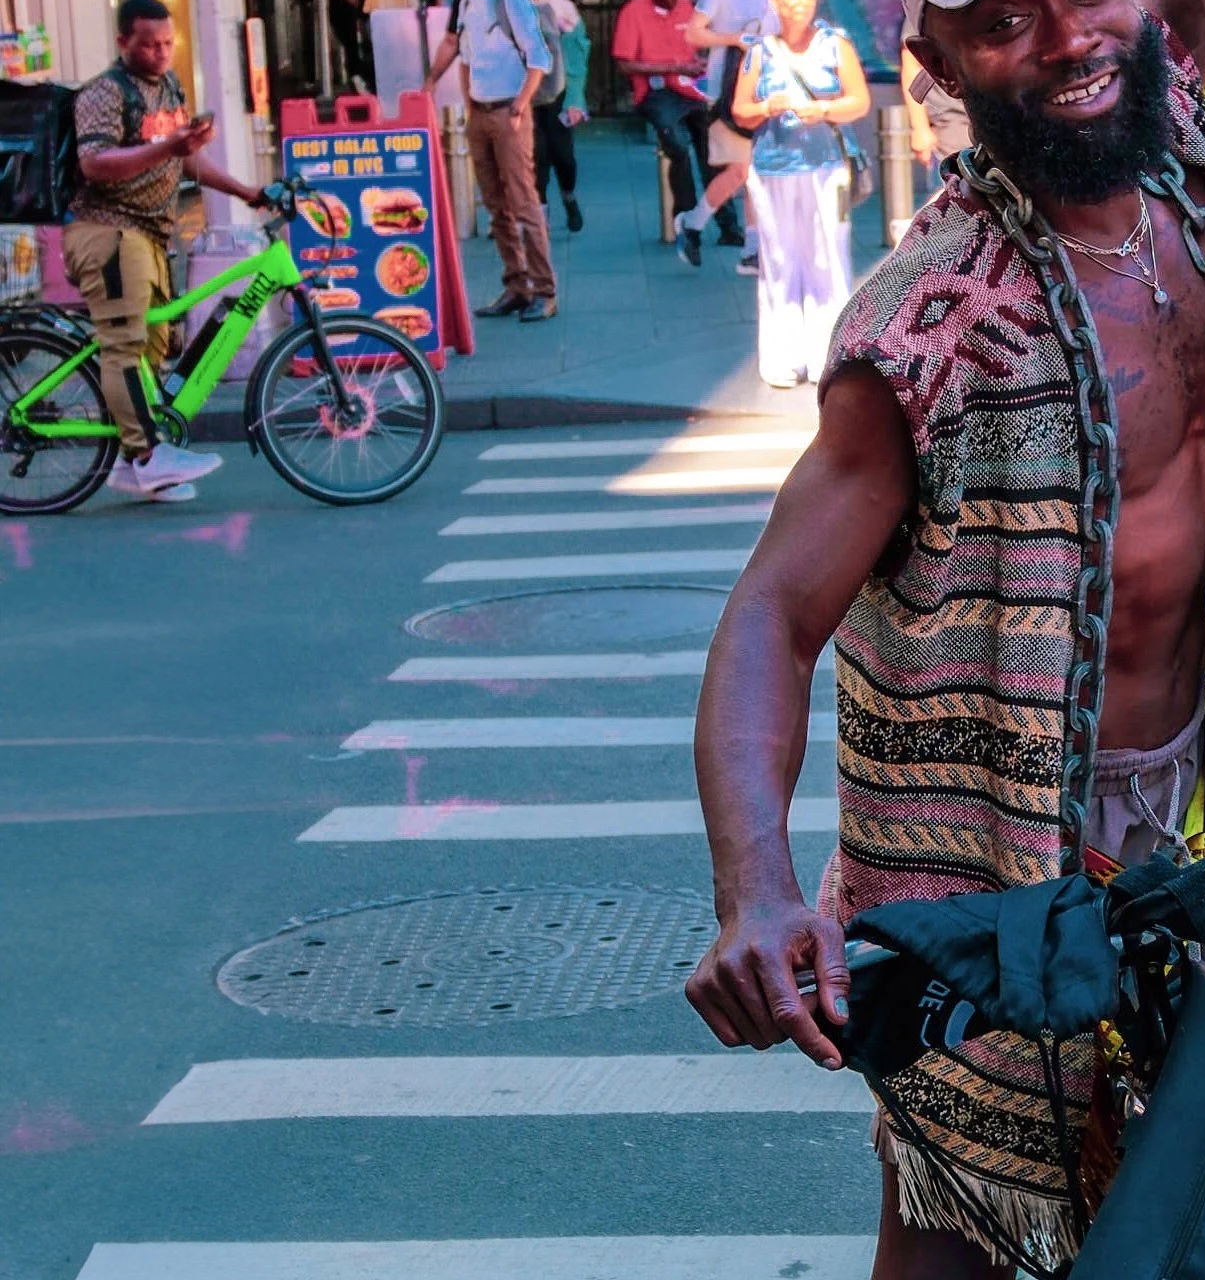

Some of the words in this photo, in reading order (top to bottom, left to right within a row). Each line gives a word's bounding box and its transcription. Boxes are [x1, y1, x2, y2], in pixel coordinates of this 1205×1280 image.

[292, 140, 328, 158] BEST
[333, 137, 379, 155] HALAL
[384, 133, 423, 152] FOOD
[332, 158, 349, 176] IN
[353, 156, 384, 175] NYC
